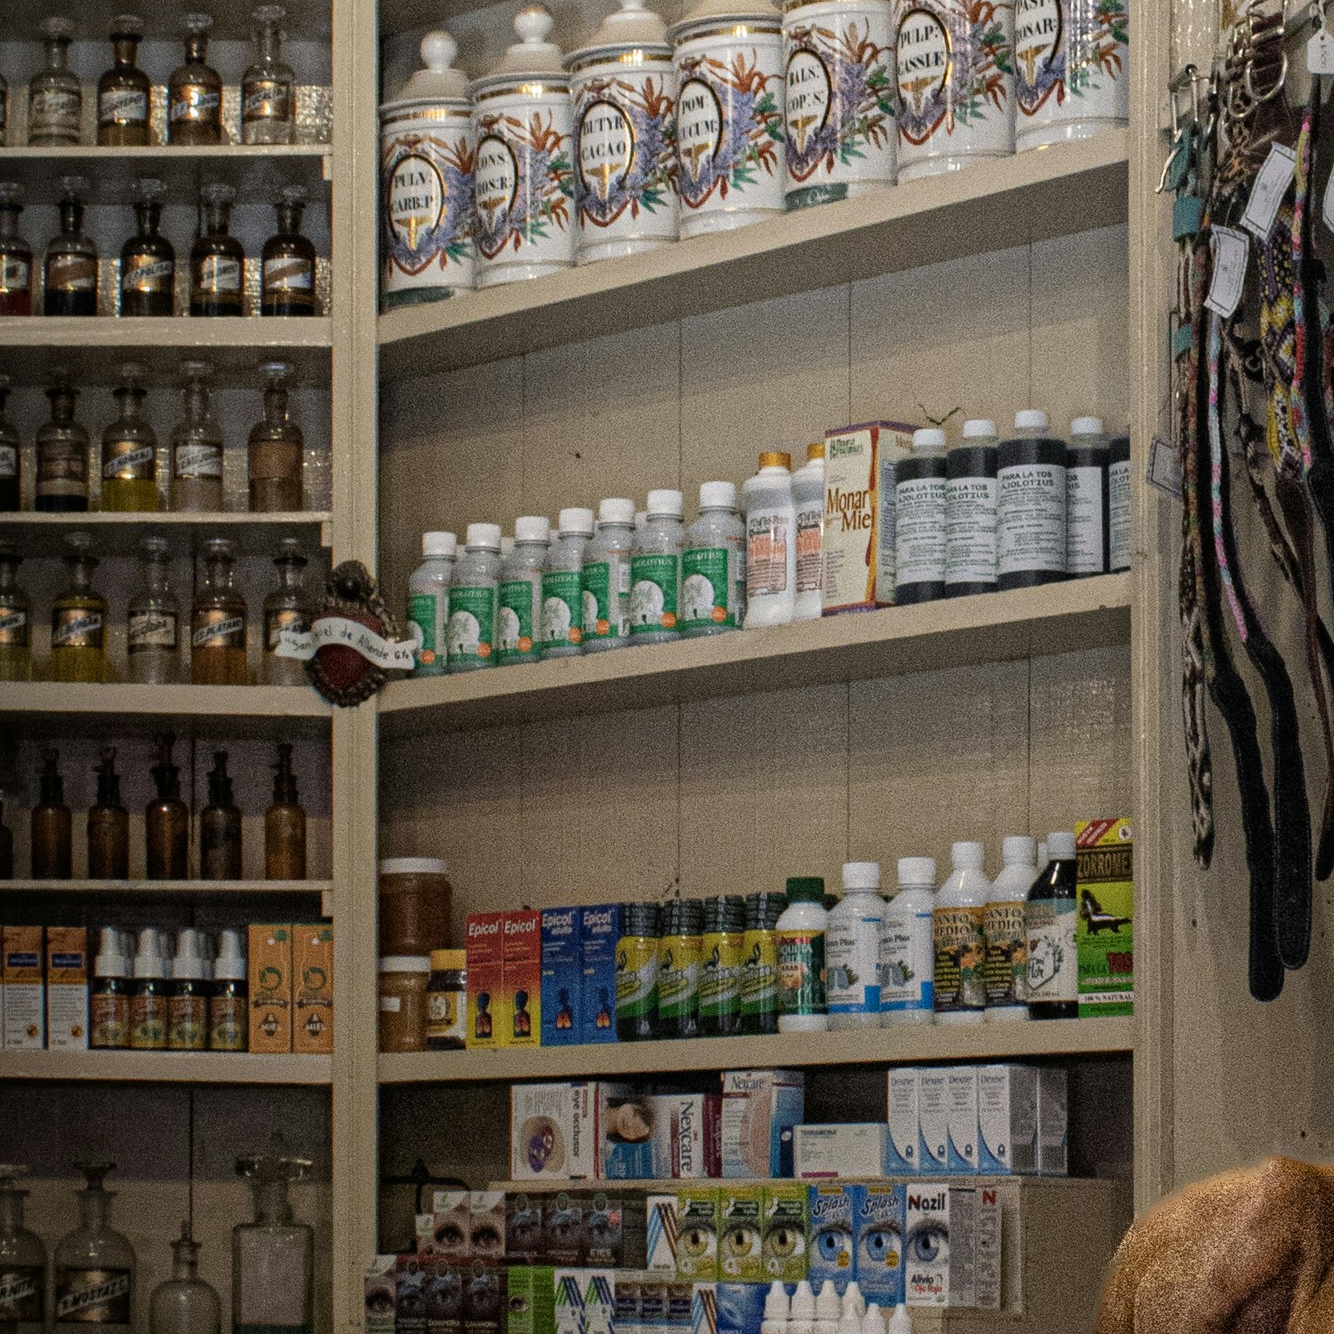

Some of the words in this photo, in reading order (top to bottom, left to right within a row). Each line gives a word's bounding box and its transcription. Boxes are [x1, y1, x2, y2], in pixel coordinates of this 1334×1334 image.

[900, 24, 939, 48] PULP:
[582, 140, 627, 163] CACAO
[826, 486, 869, 515] Monar
[504, 918, 537, 936] Epicol
[542, 911, 572, 929] Epicol
[583, 909, 613, 927] Epicol
[468, 920, 500, 938] Epicol
[730, 1075, 765, 1092] Nexcare
[680, 1100, 695, 1174] Nexcare
[861, 1197, 899, 1216] Splash
[907, 1192, 946, 1212] Nazil
[982, 1190, 997, 1205] N
[812, 1198, 850, 1217] Splash
